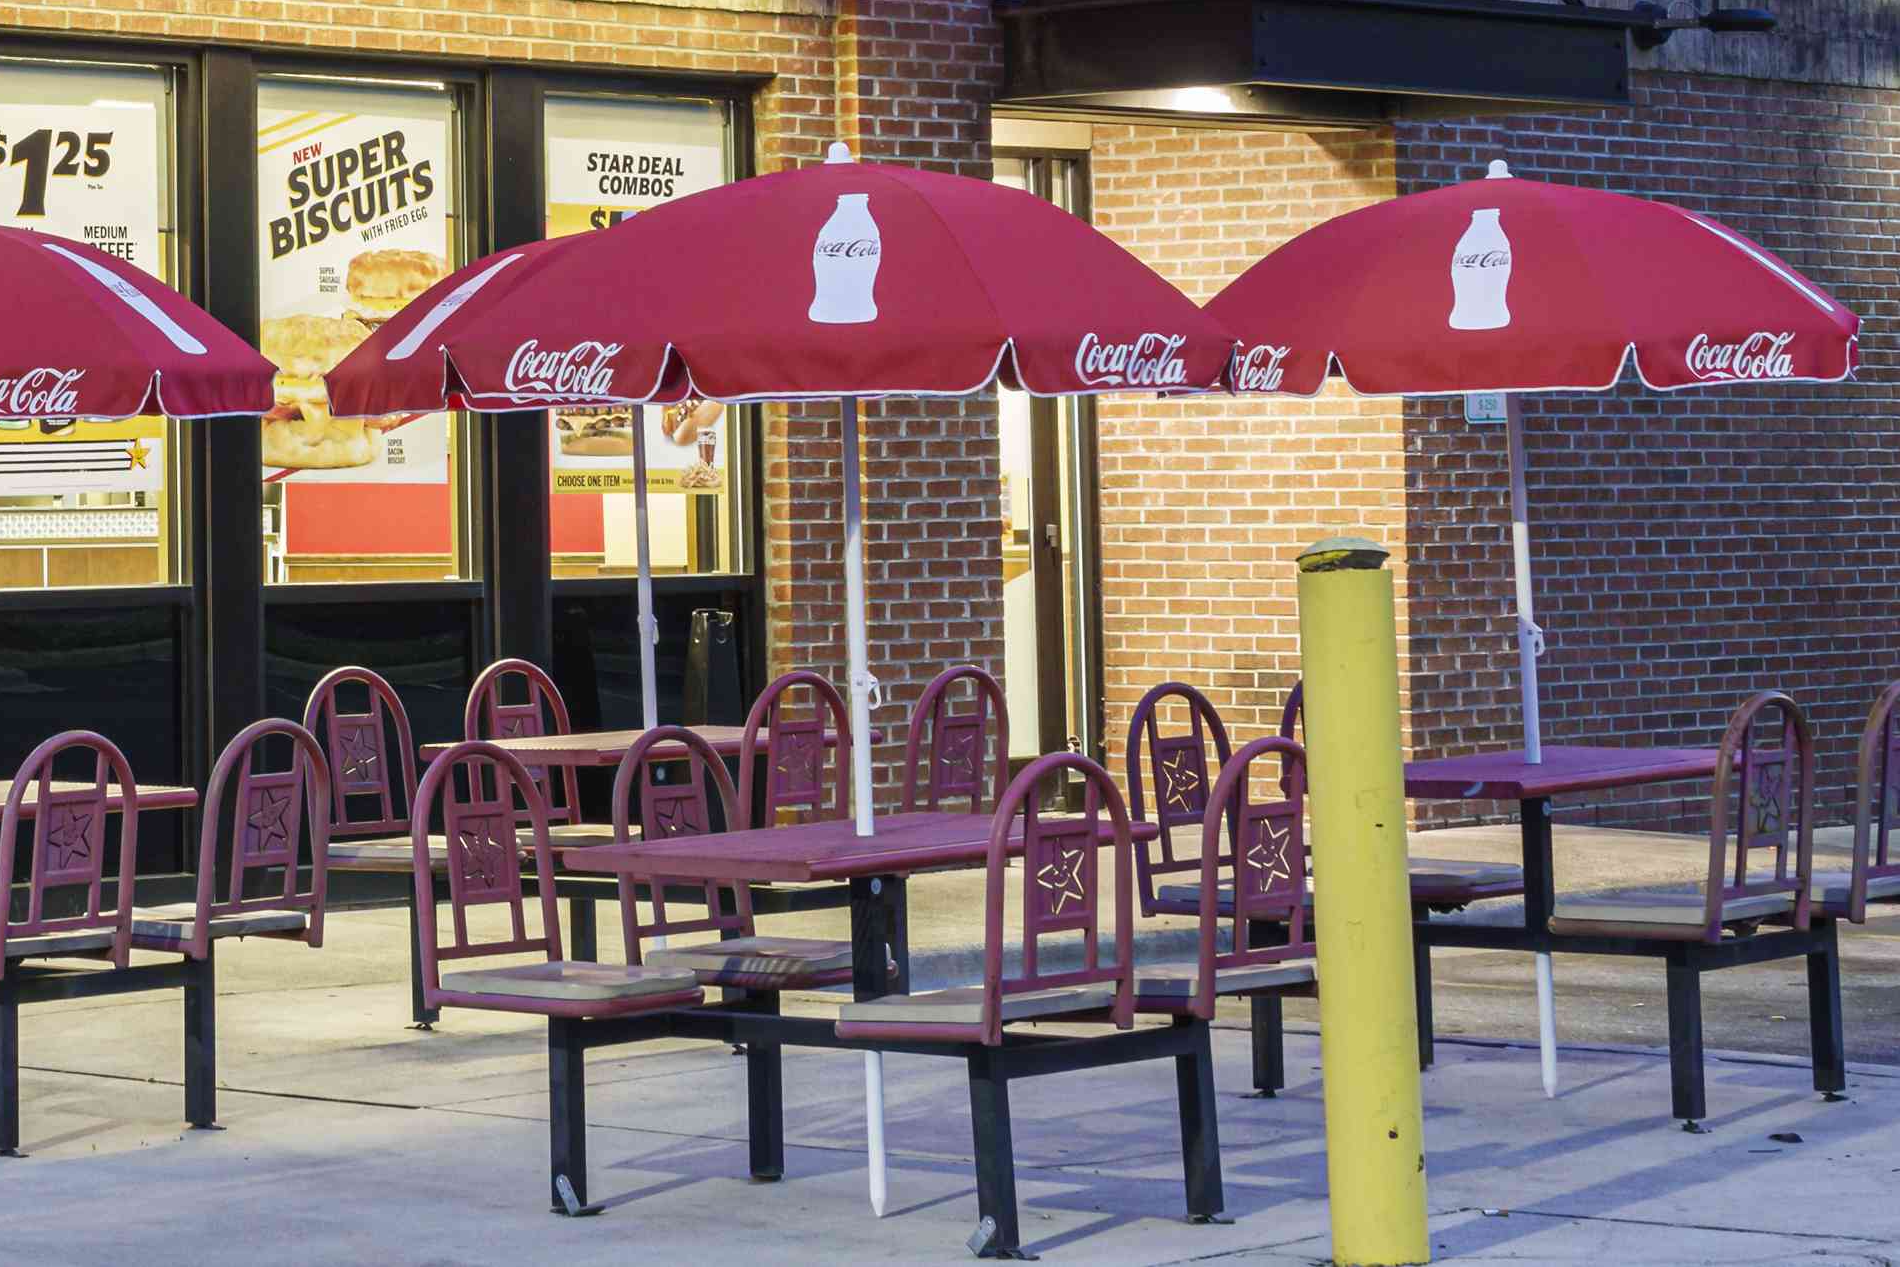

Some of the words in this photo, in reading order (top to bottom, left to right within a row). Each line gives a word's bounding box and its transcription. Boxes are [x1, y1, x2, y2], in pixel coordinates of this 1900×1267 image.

[292, 142, 322, 165] NEW
[587, 152, 634, 174] STAR
[638, 156, 685, 176] DEAL
[288, 130, 408, 209] SUPER
[599, 175, 674, 197] COMBOS
[269, 160, 434, 259] BISCUITS
[84, 226, 128, 238] MEDIUM
[361, 225, 384, 243] WITH
[385, 213, 410, 234] FRIED
[412, 206, 428, 223] EGG
[818, 238, 878, 257] oca-Cola
[557, 475, 585, 487] CHOOSE
[588, 475, 601, 486] ONE
[603, 475, 620, 486] ITEM
